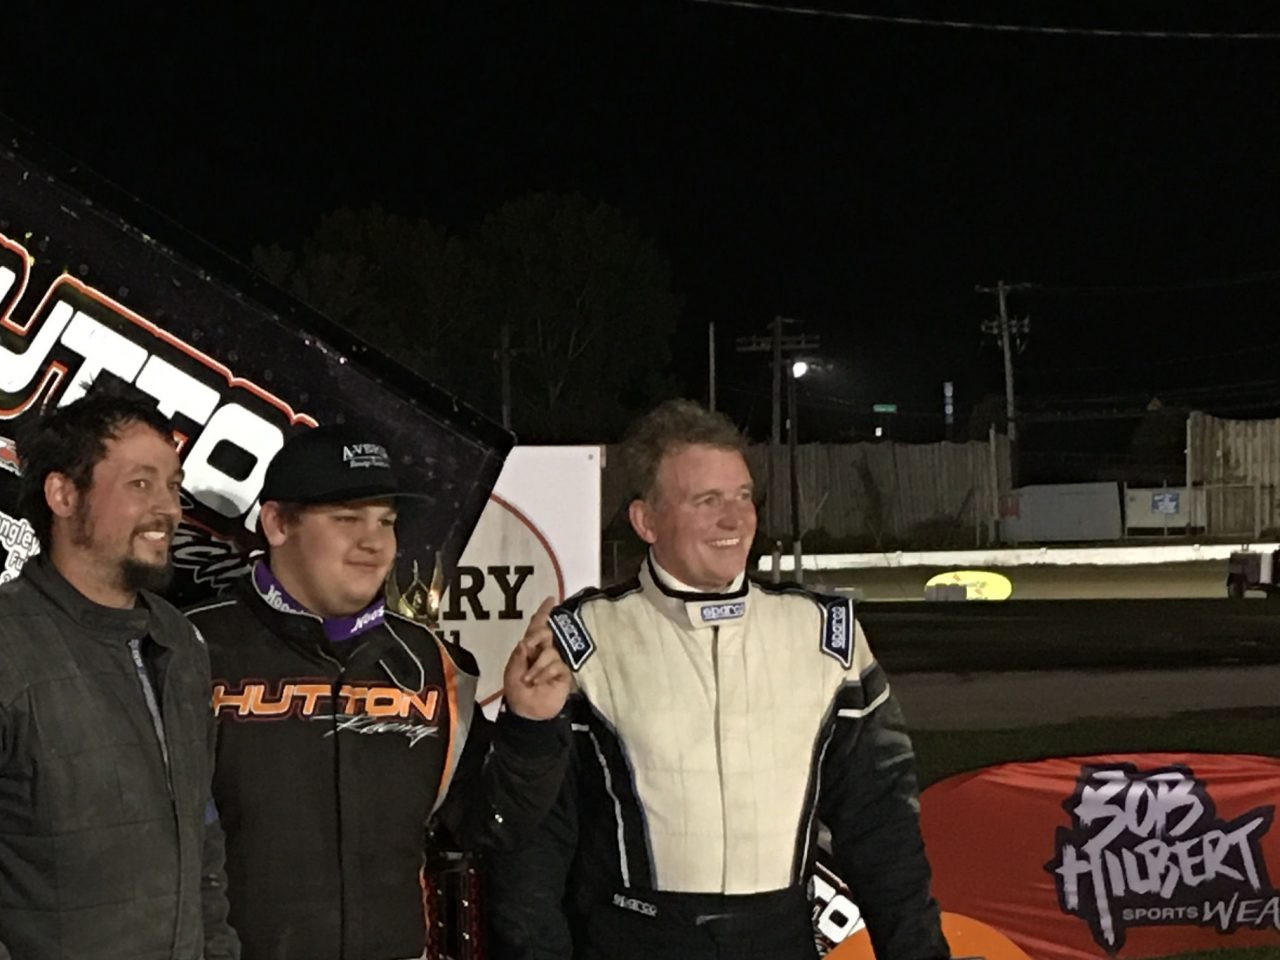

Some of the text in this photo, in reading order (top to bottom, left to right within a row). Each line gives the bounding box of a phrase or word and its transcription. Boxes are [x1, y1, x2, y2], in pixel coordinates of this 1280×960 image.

[831, 605, 846, 649] sparco
[211, 684, 438, 720] HUTTON
[1122, 892, 1280, 930] SPORTS WEA
